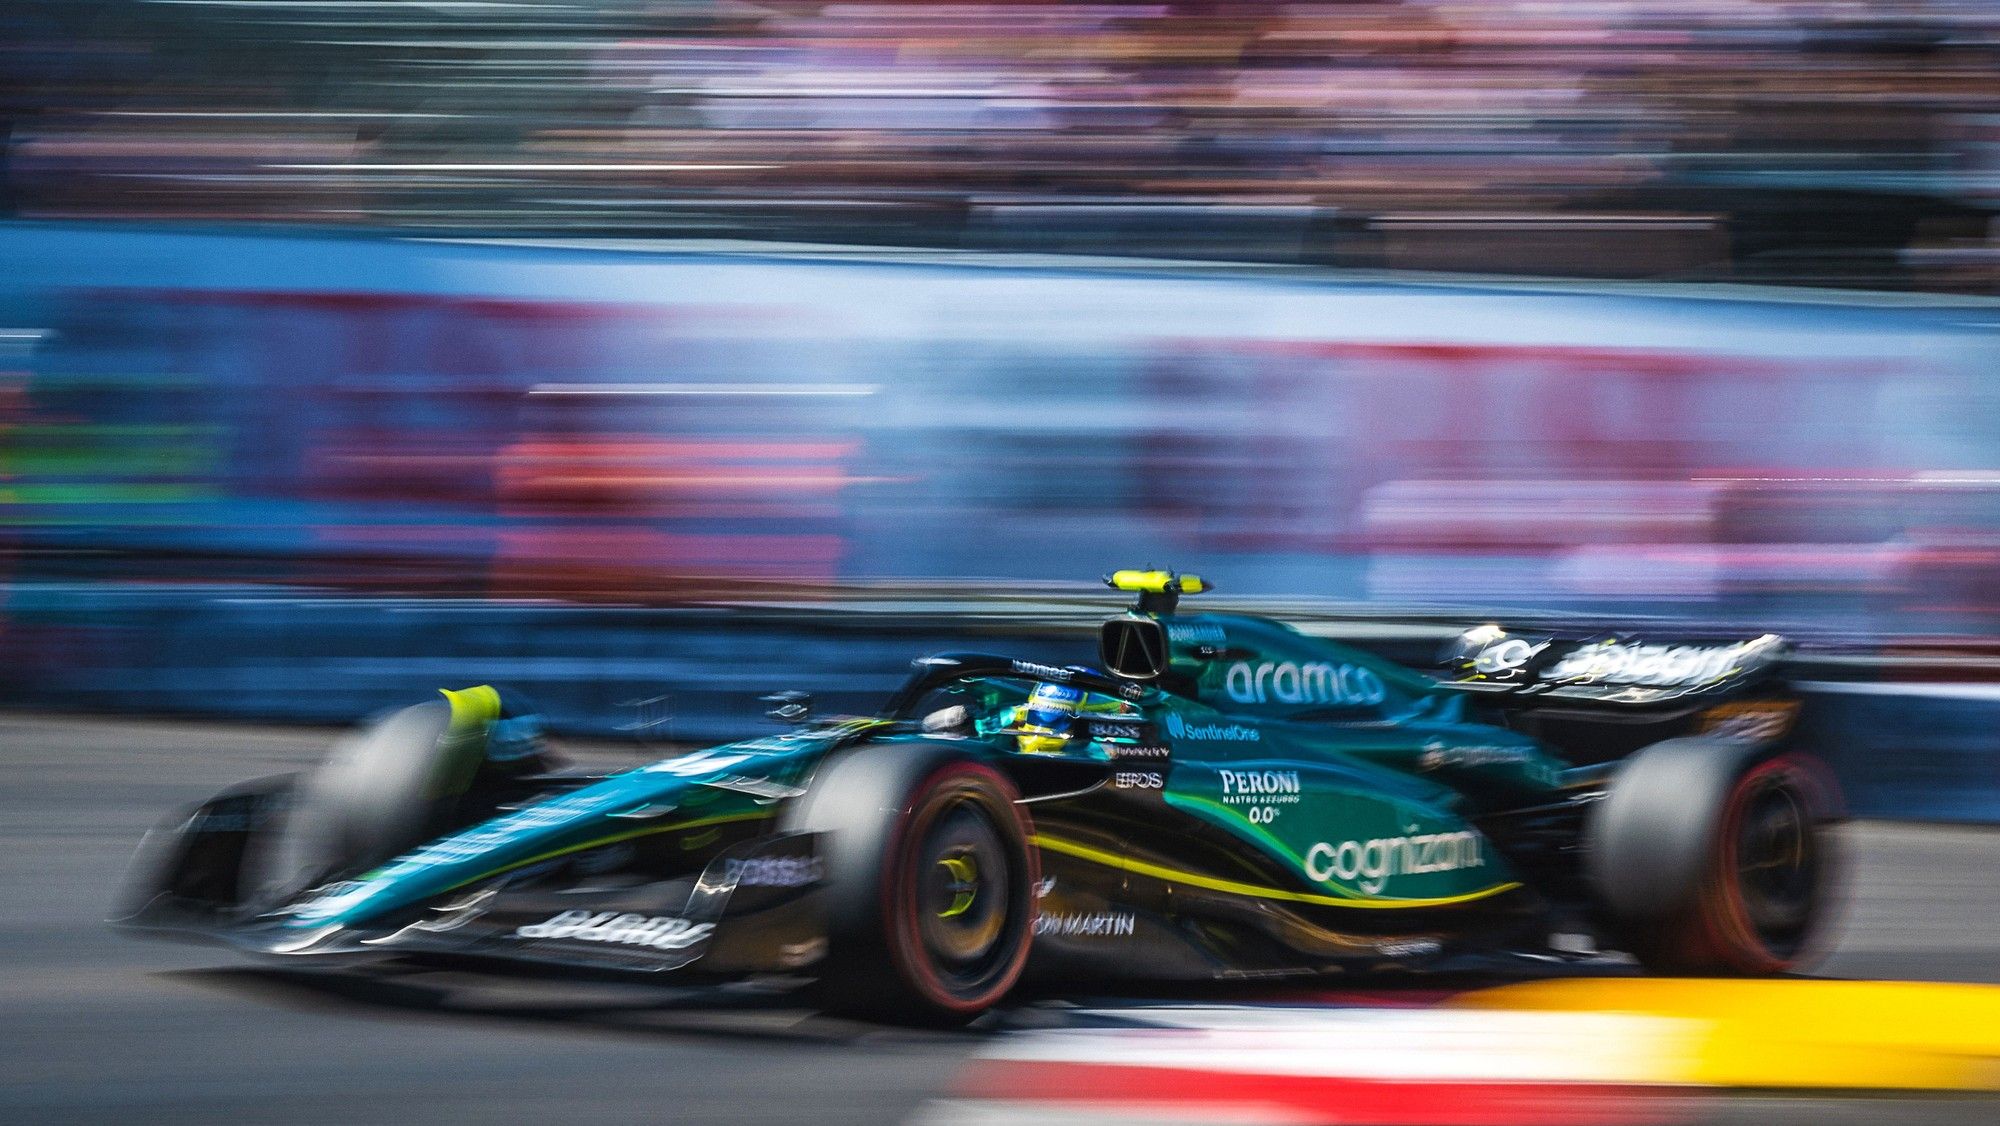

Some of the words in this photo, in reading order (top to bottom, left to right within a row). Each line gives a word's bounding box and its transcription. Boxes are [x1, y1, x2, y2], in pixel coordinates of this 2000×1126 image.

[1226, 661, 1386, 705] aramco
[1184, 722, 1261, 742] SentinelOne
[1219, 769, 1300, 794] PERONI
[1222, 795, 1258, 804] NASTRO
